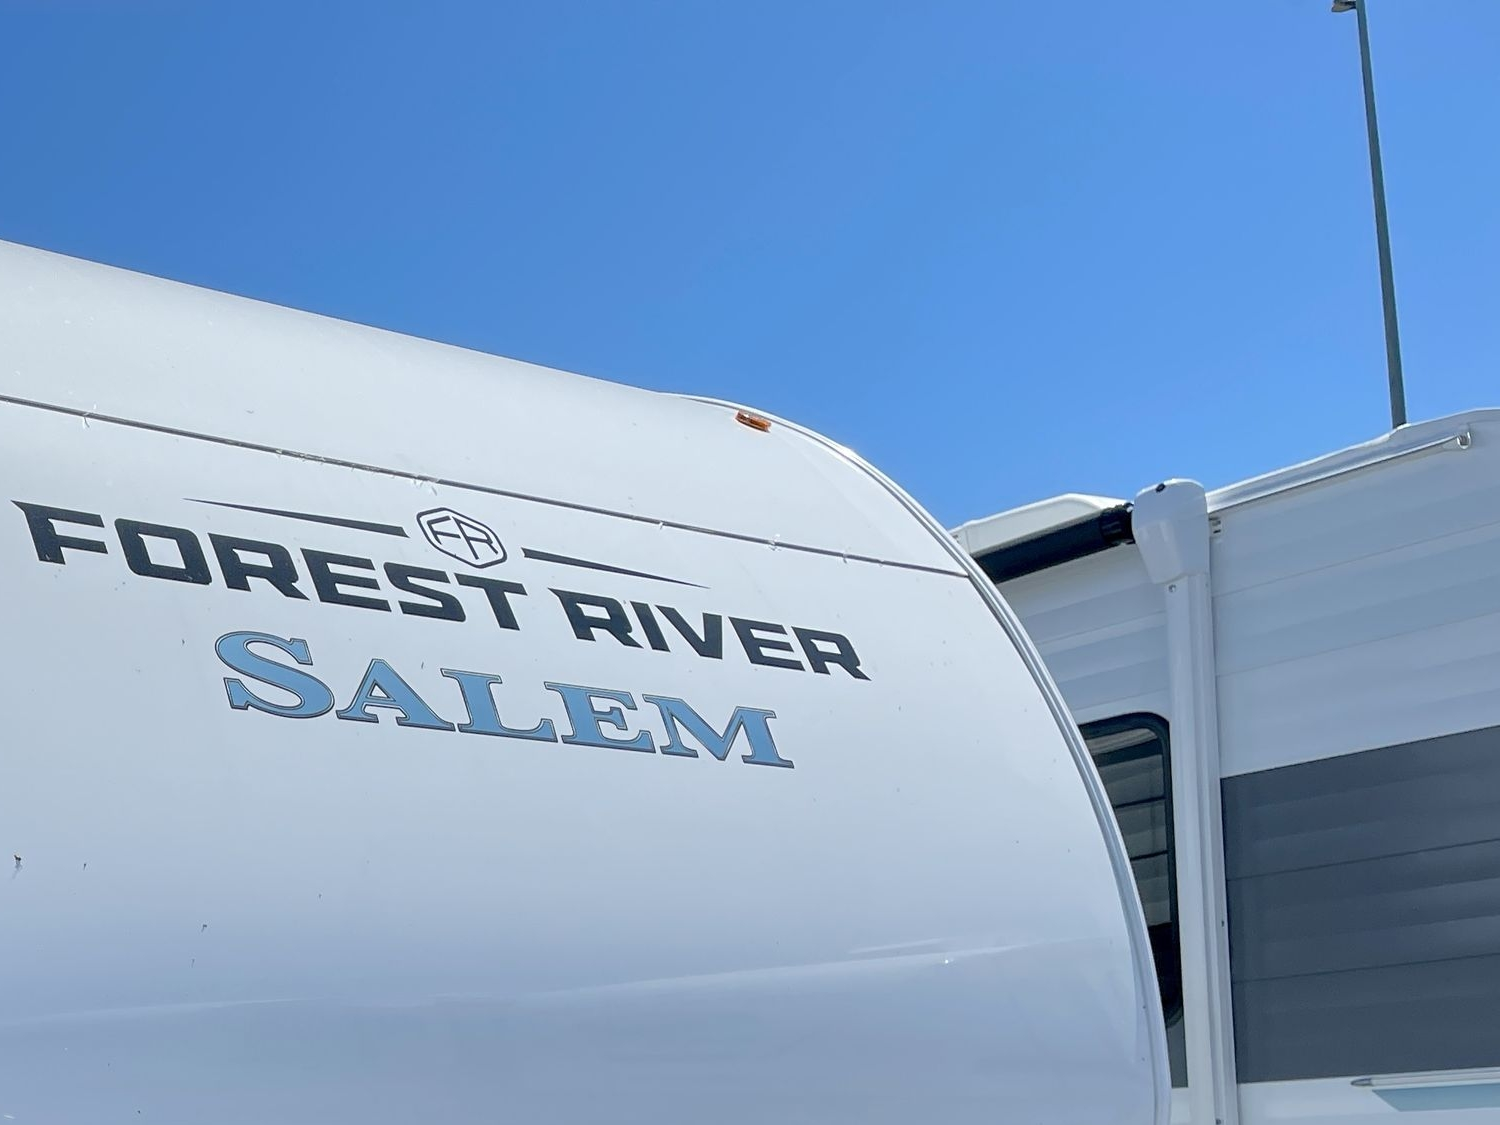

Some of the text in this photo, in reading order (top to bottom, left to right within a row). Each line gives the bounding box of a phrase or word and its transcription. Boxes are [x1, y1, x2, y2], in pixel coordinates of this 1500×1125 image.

[11, 499, 872, 681] FOREST RIVER
[214, 630, 795, 769] SALEM
